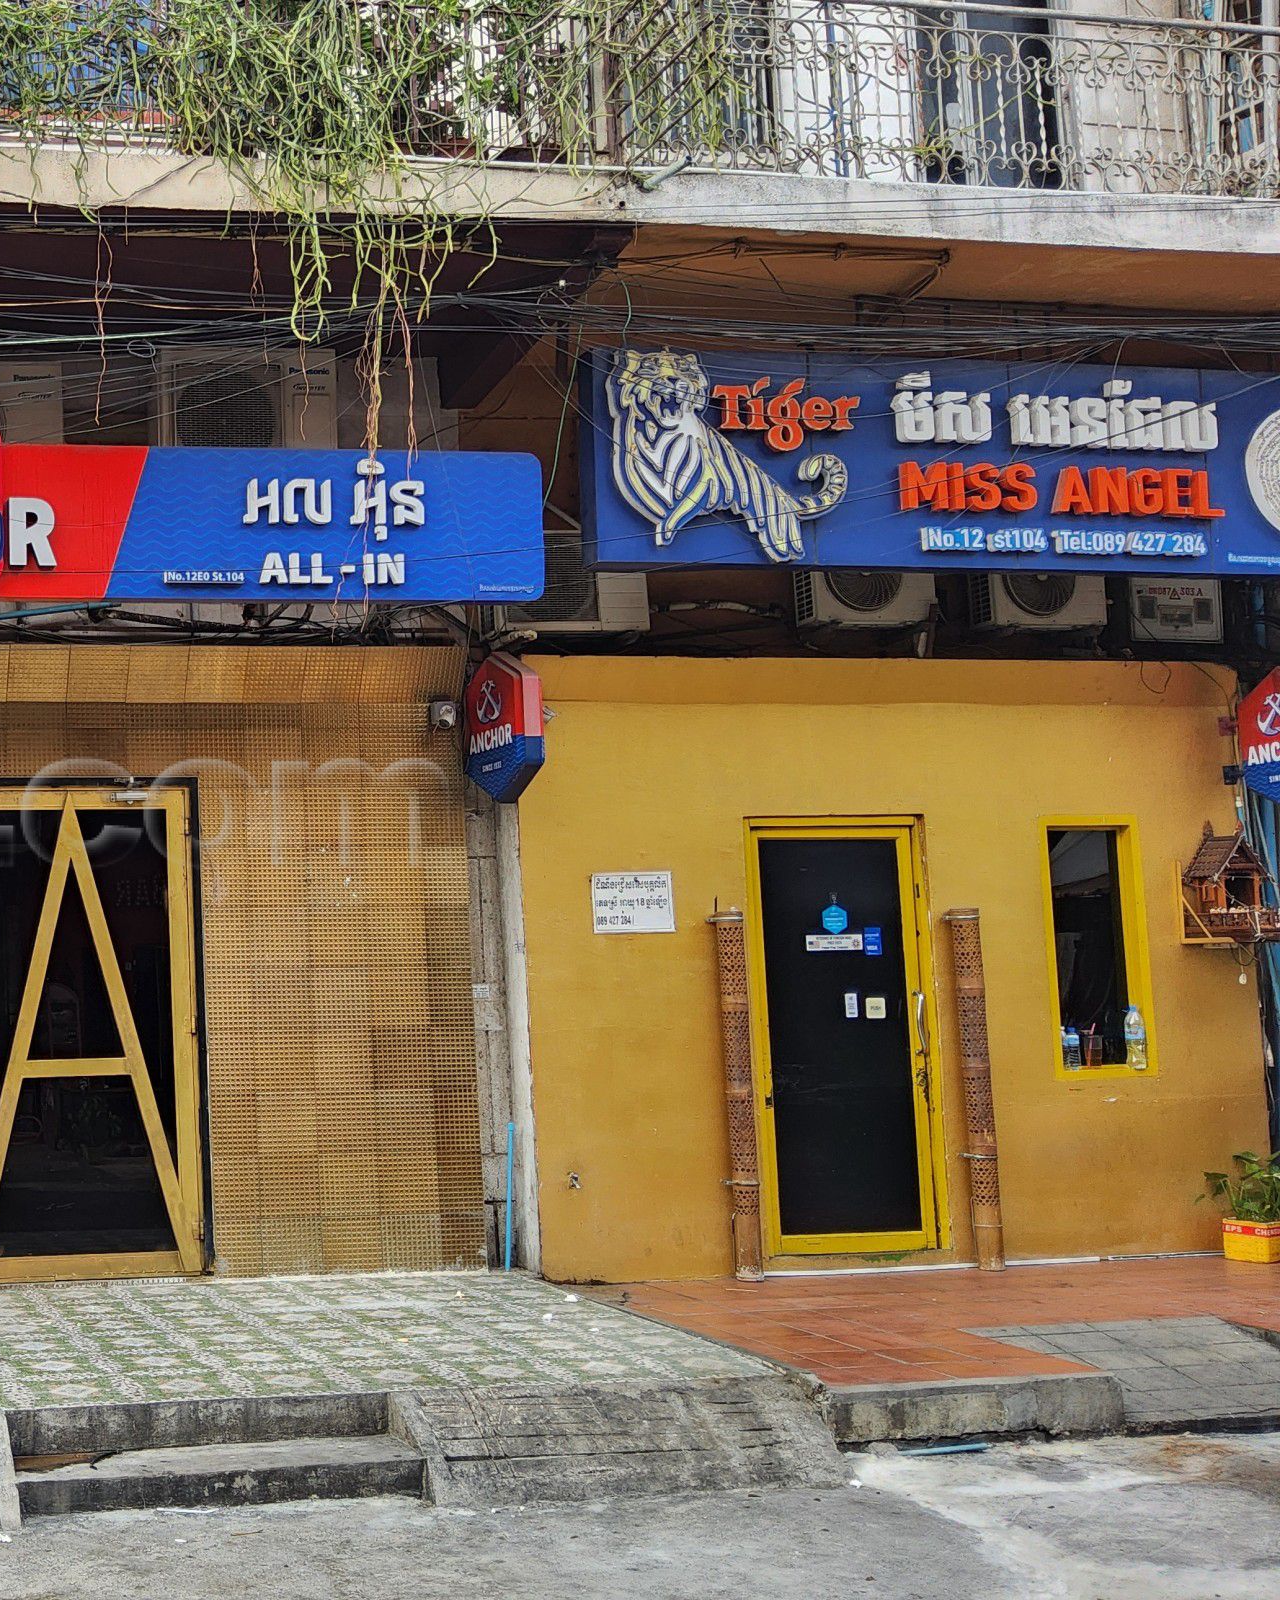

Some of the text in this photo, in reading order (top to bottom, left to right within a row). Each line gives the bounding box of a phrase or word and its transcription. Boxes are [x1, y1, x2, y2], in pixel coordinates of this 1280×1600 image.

[712, 376, 861, 451] Tiger
[899, 461, 1038, 512] MISS
[1050, 465, 1226, 518] ANGEL
[923, 527, 985, 550] No.12
[989, 528, 1048, 552] st104
[1129, 532, 1167, 554] 427
[1170, 533, 1208, 556] 284
[470, 723, 513, 755] ANCHOR
